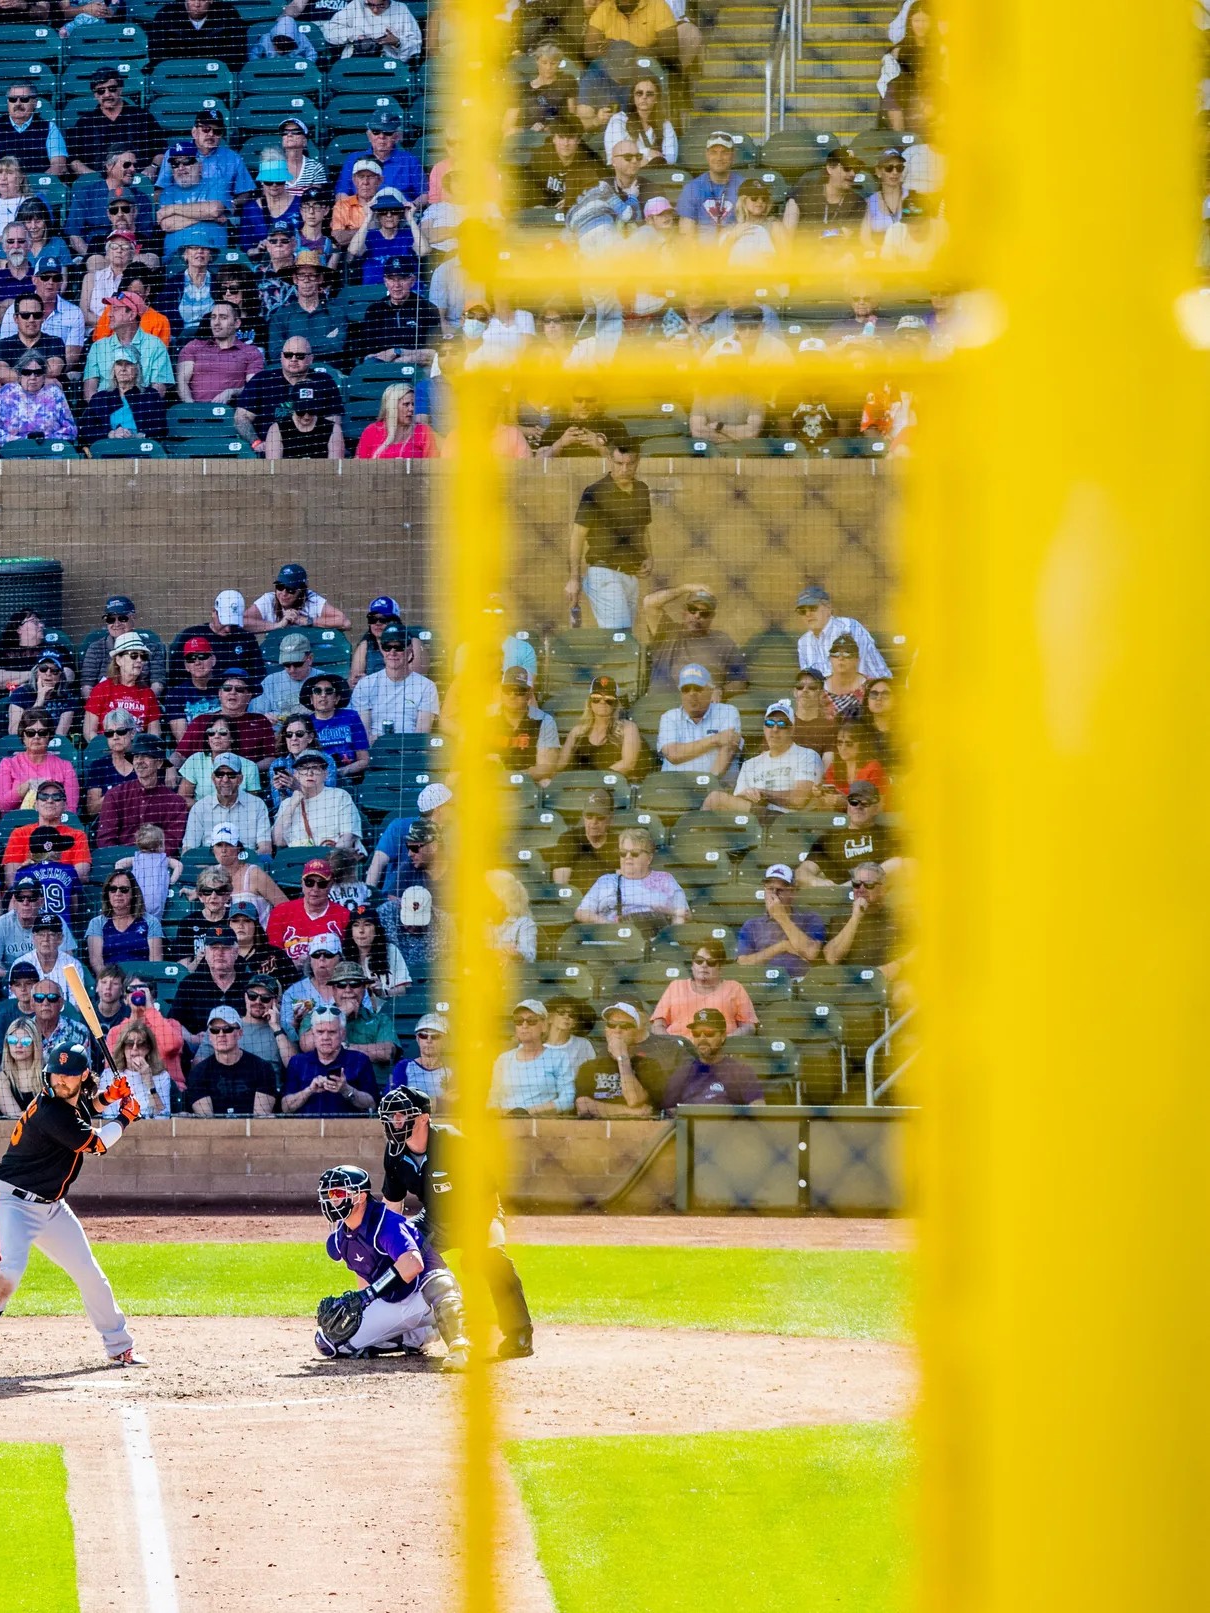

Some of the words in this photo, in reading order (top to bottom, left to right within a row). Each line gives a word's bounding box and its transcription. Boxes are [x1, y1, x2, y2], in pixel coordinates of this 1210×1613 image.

[117, 702, 145, 711] WOMAN
[40, 883, 65, 914] 19
[59, 1052, 69, 1066] SF
